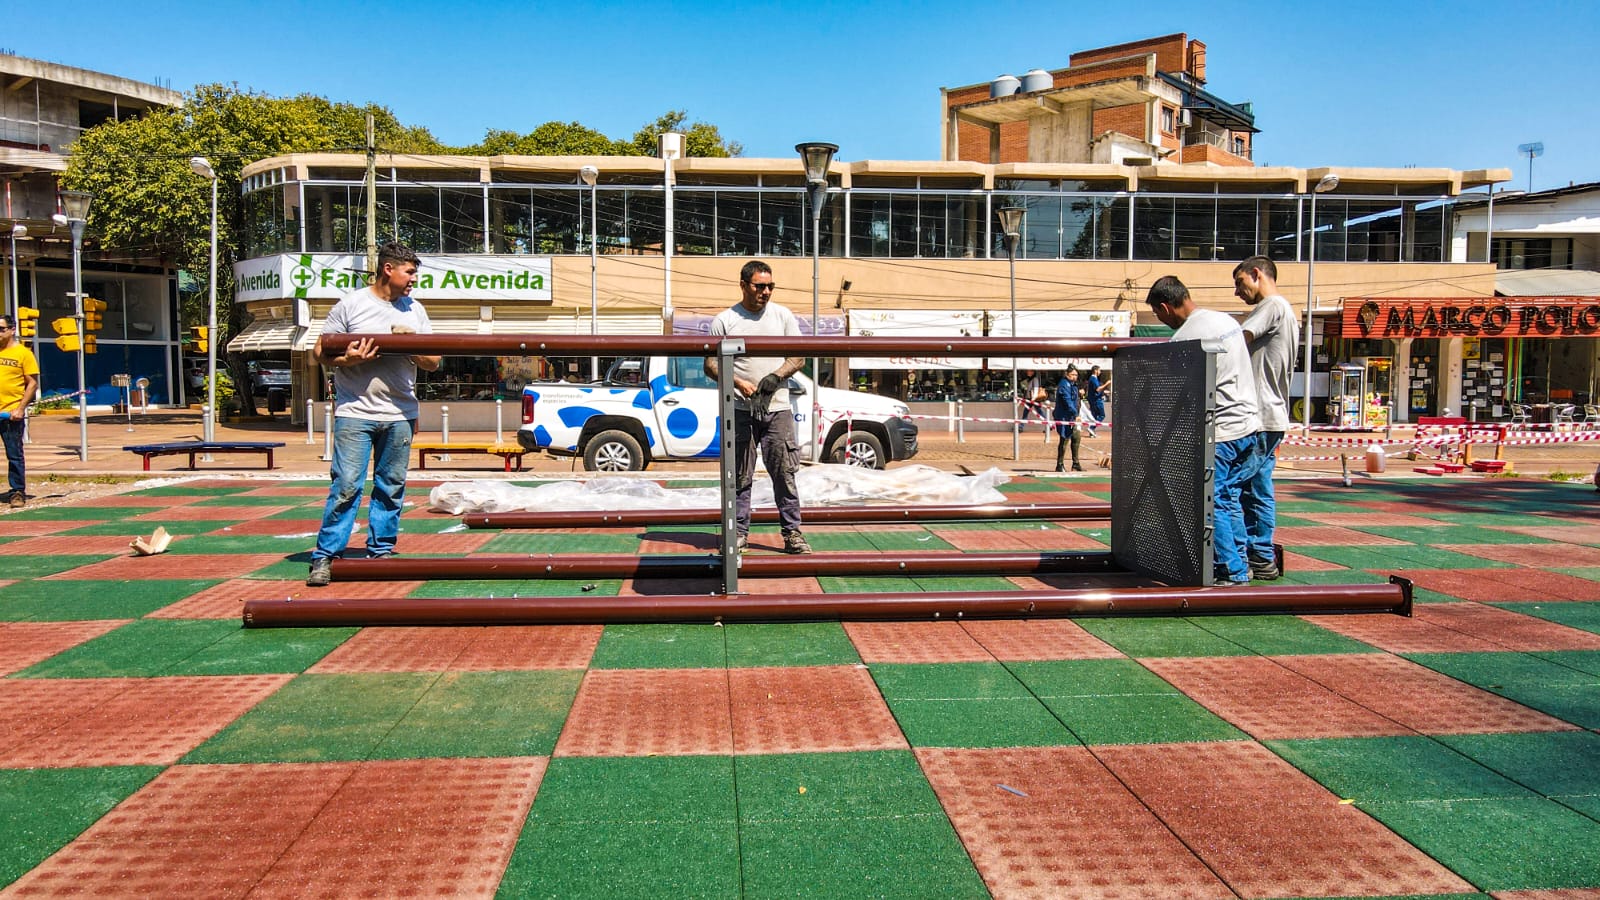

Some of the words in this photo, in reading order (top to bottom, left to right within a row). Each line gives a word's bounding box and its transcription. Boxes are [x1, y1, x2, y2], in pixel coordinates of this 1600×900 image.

[241, 270, 280, 292] Avenida
[440, 265, 544, 290] Avenida
[1386, 305, 1512, 332] MARCO
[1520, 305, 1600, 332] POLO
